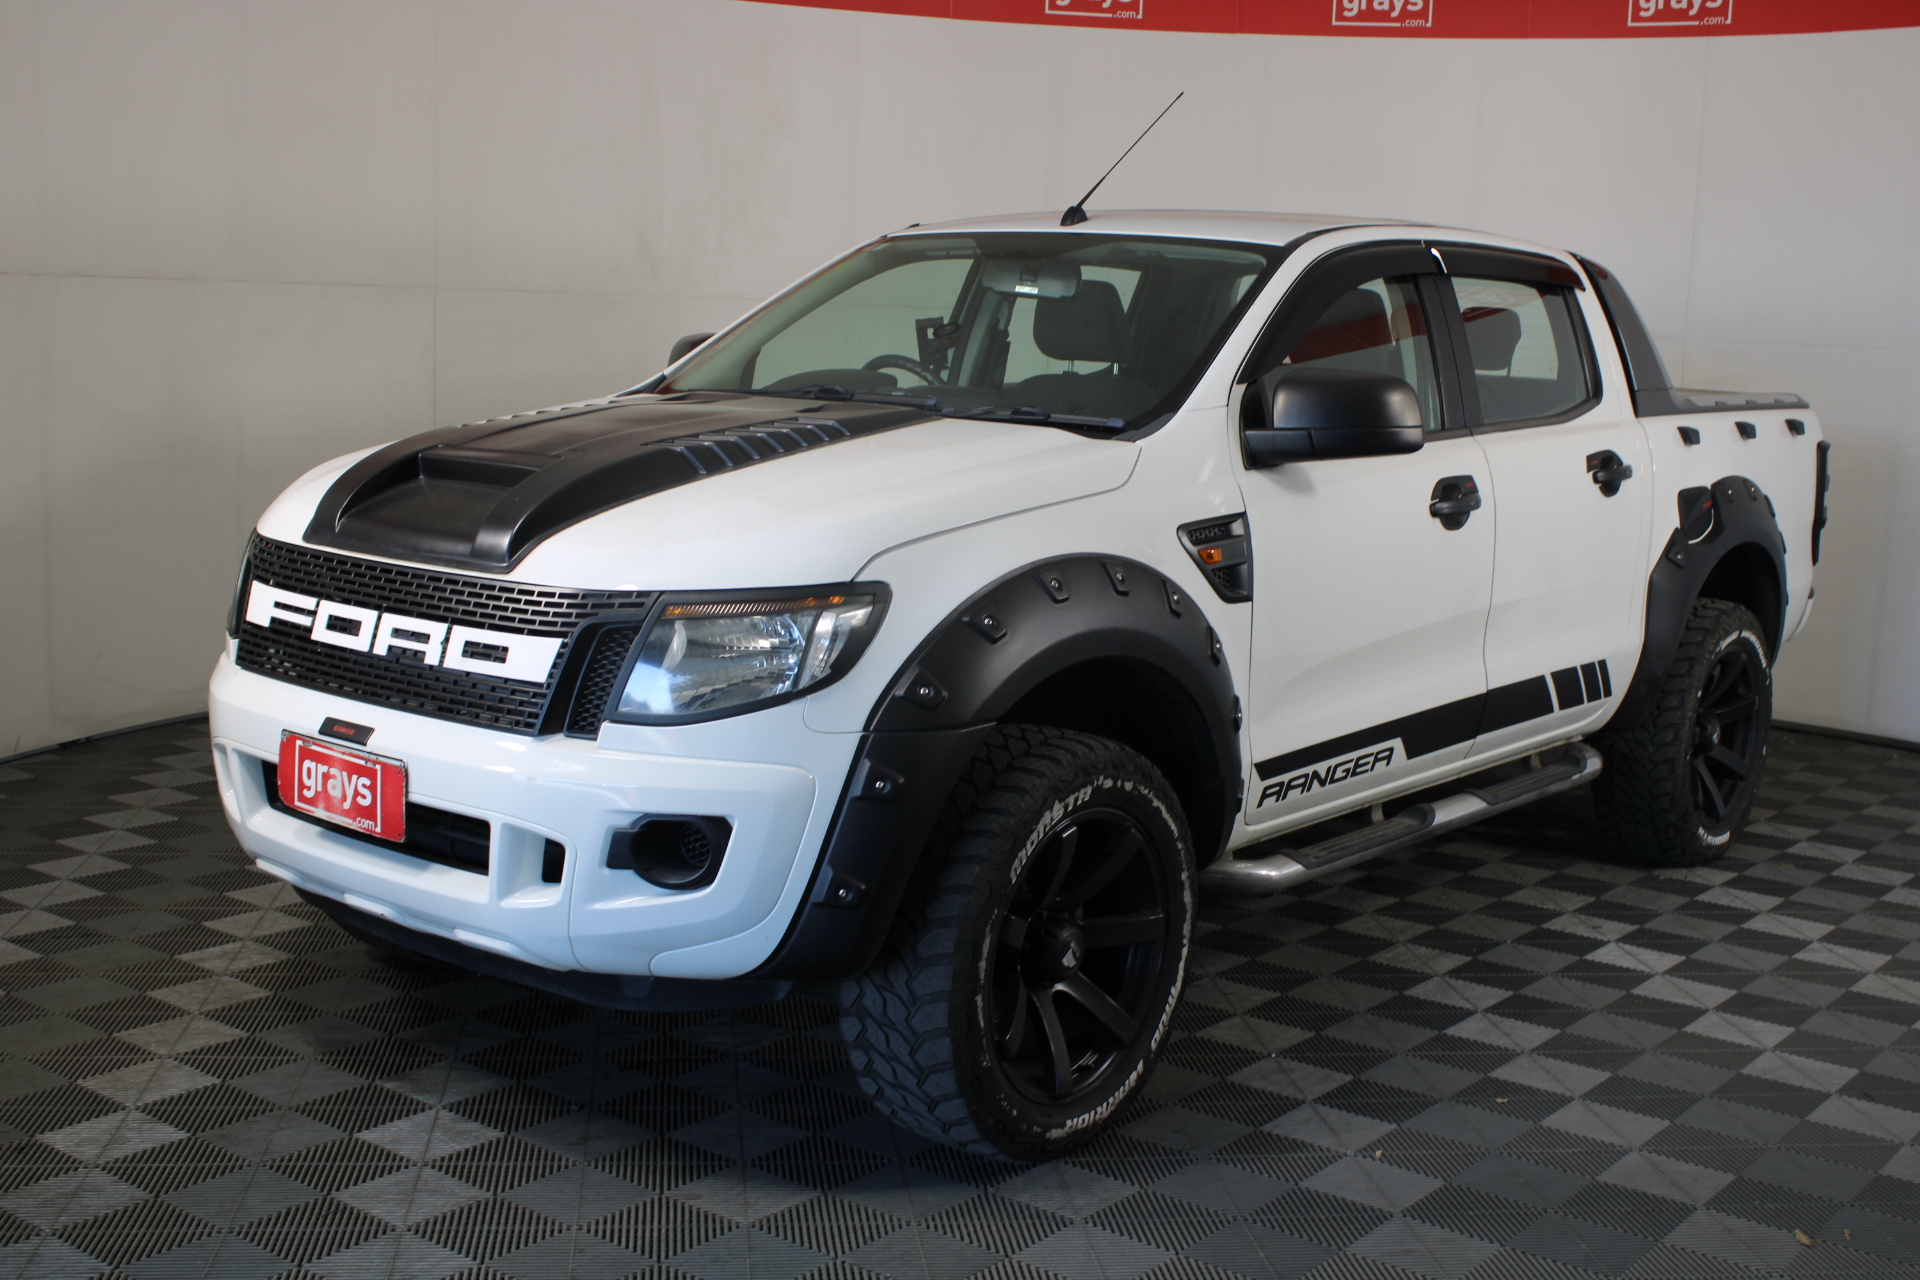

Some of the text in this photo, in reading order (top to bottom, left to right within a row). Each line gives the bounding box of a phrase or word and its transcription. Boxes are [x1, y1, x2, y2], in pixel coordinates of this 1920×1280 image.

[1113, 10, 1136, 19] .com
[1700, 16, 1725, 25] .com
[1401, 19, 1426, 27] .com
[245, 579, 565, 684] FORD
[1256, 746, 1395, 808] RANGER
[302, 759, 373, 810] grays
[352, 817, 375, 831] .com
